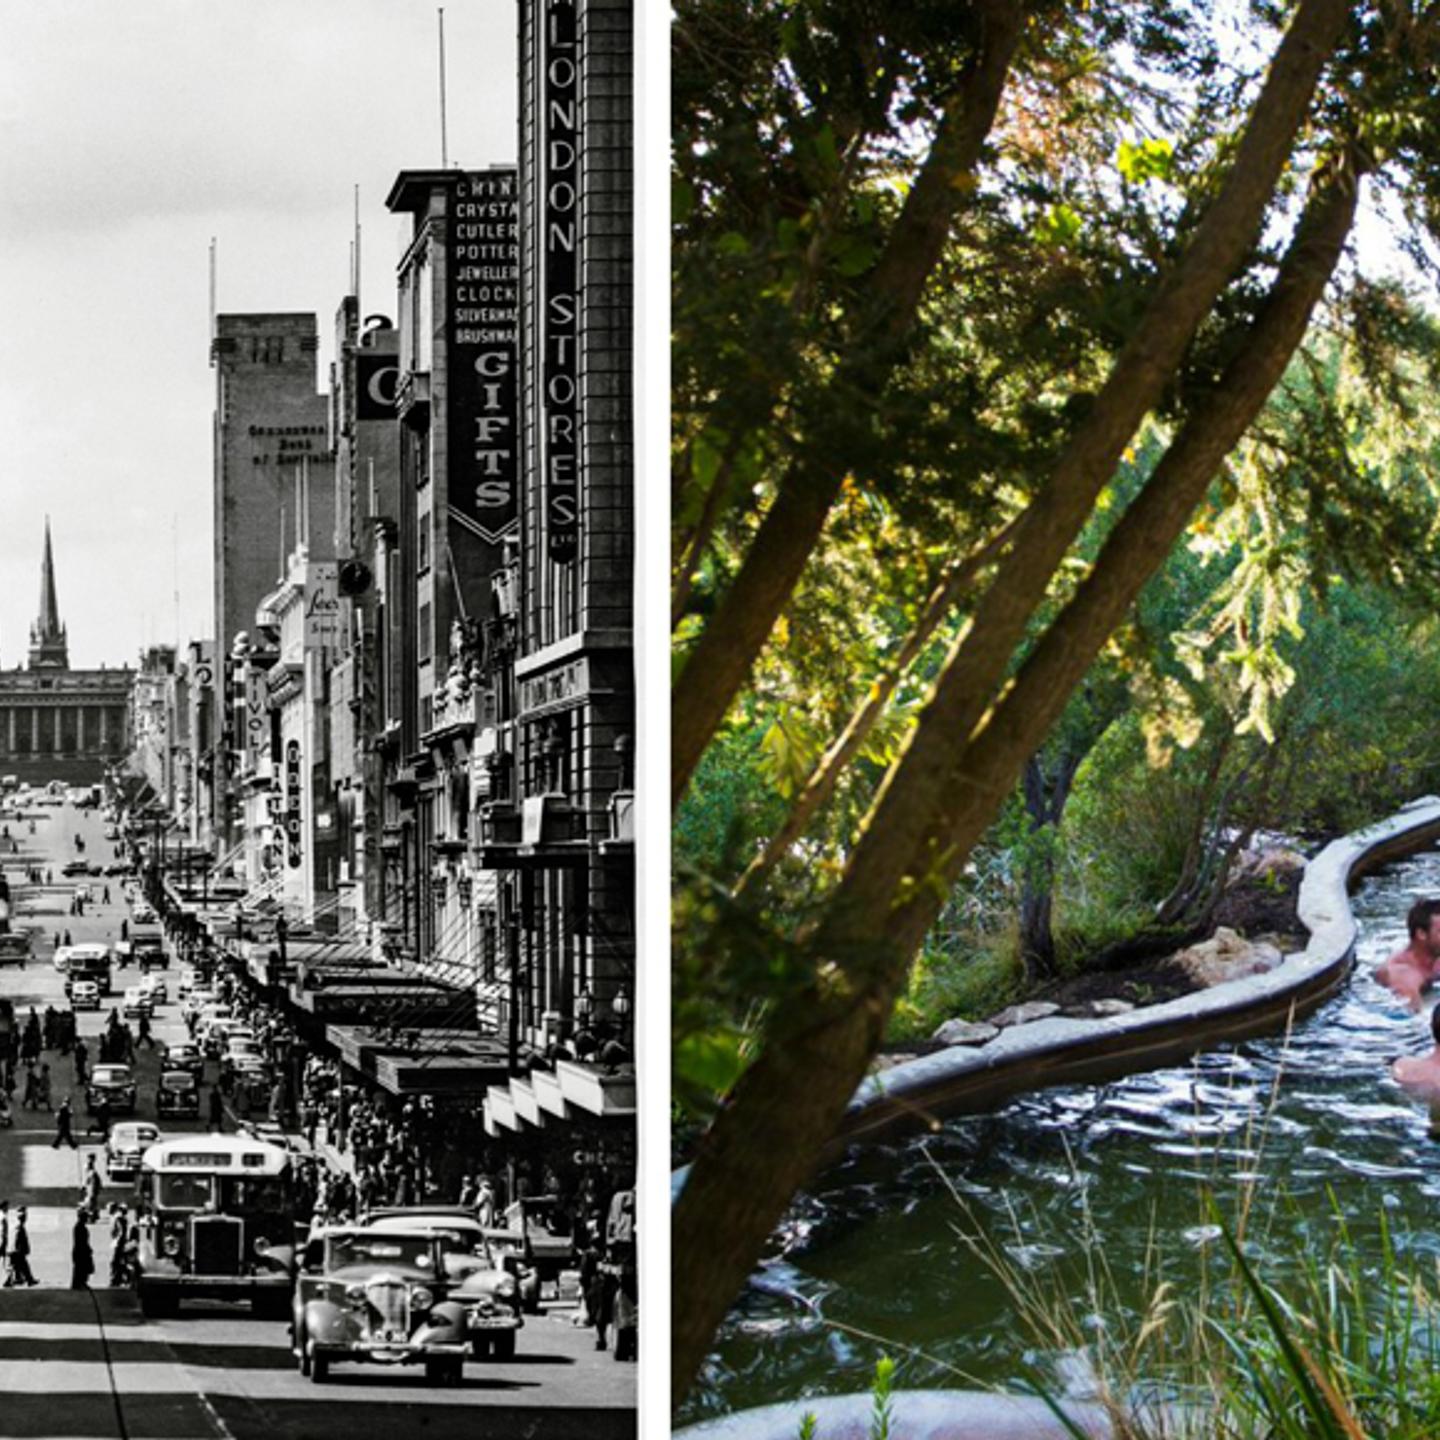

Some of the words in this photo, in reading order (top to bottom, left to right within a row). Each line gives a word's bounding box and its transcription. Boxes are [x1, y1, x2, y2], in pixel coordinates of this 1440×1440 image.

[548, 14, 575, 252] LONDON
[456, 181, 518, 198] CHIN
[456, 202, 519, 218] CRYSTA
[456, 223, 519, 239] CUTLER
[456, 244, 519, 260] POTTER
[456, 265, 519, 281] JEWELLER
[456, 286, 517, 302] CLOCK
[548, 293, 576, 526] STORES
[474, 351, 511, 508] GIFTS
